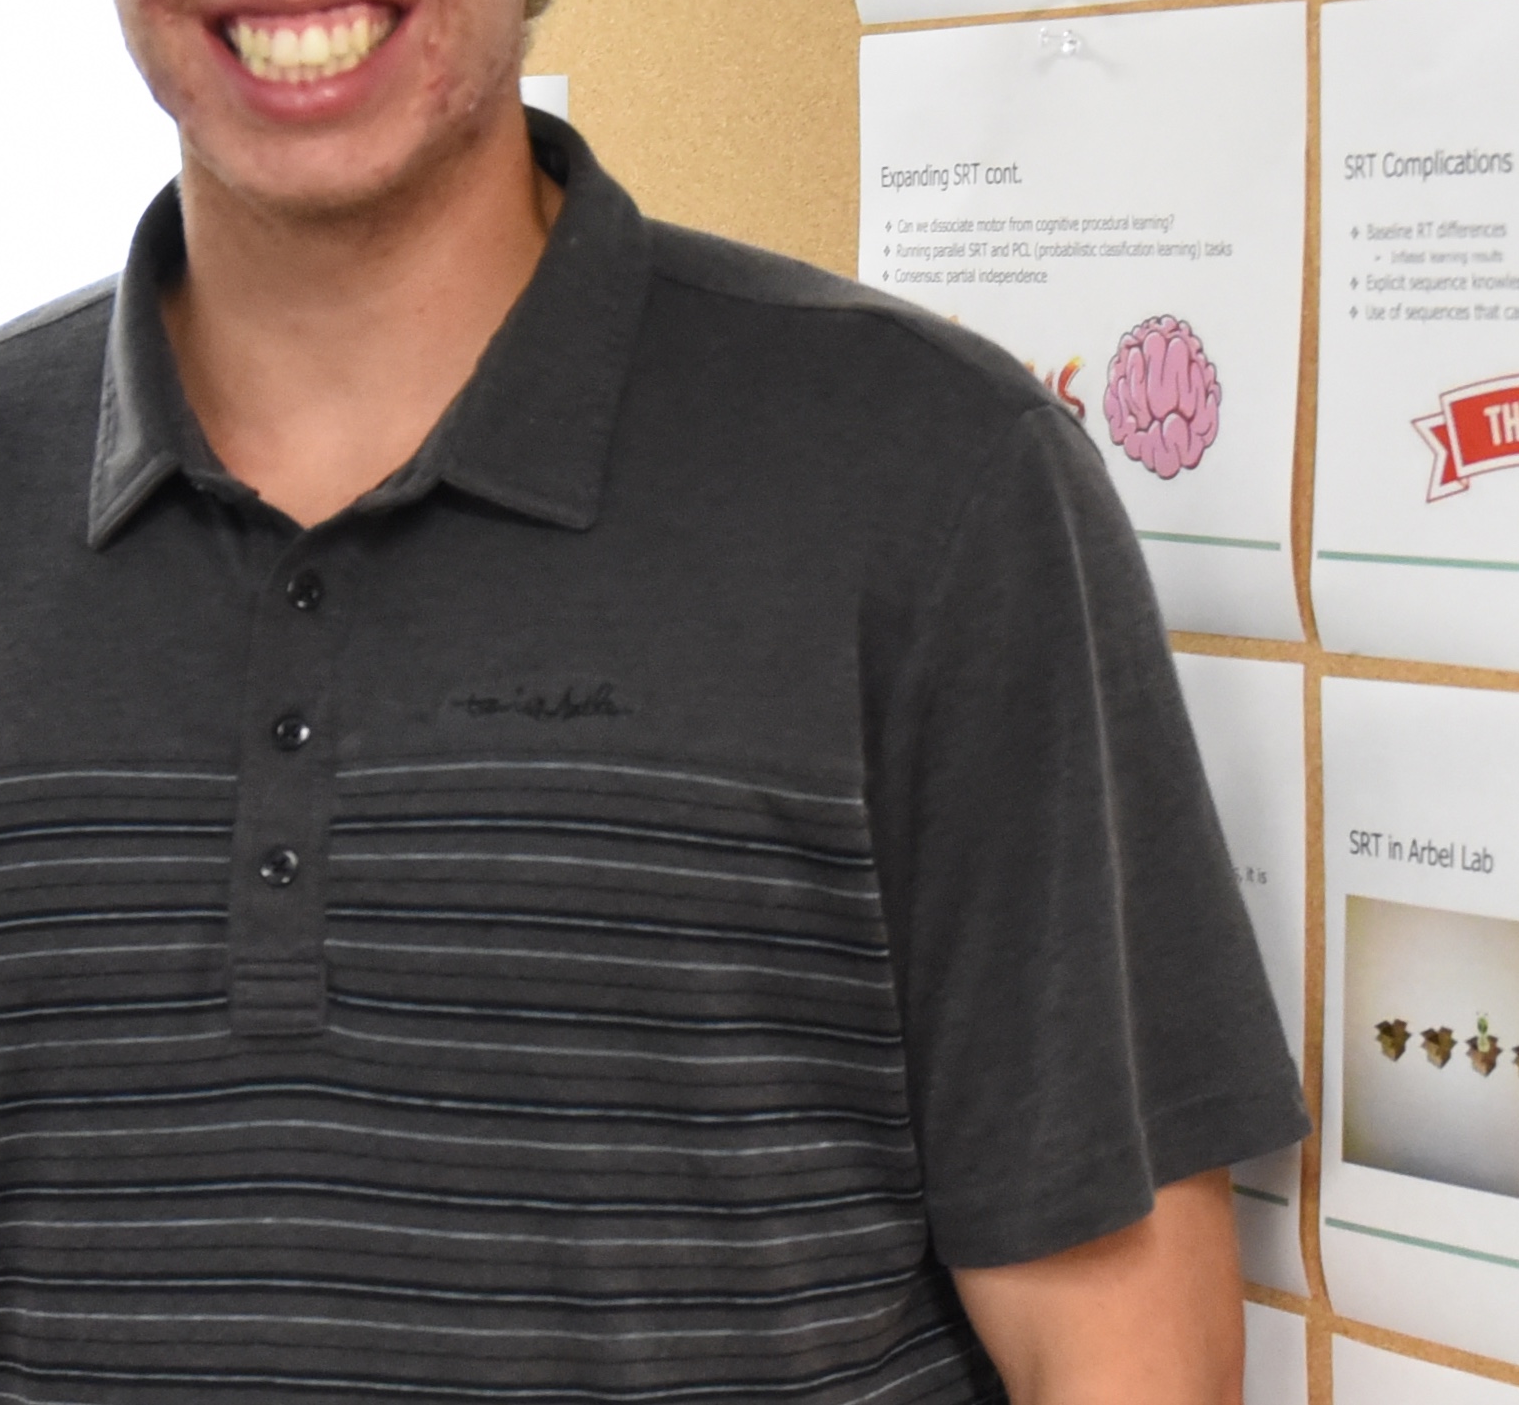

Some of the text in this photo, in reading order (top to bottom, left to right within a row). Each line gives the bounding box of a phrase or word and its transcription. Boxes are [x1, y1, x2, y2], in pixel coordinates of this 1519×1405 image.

[881, 162, 1022, 191] Expanding SRT cont.
[1344, 150, 1514, 181] SRT Complications
[1349, 830, 1494, 874] SRT in Arbel Lab
